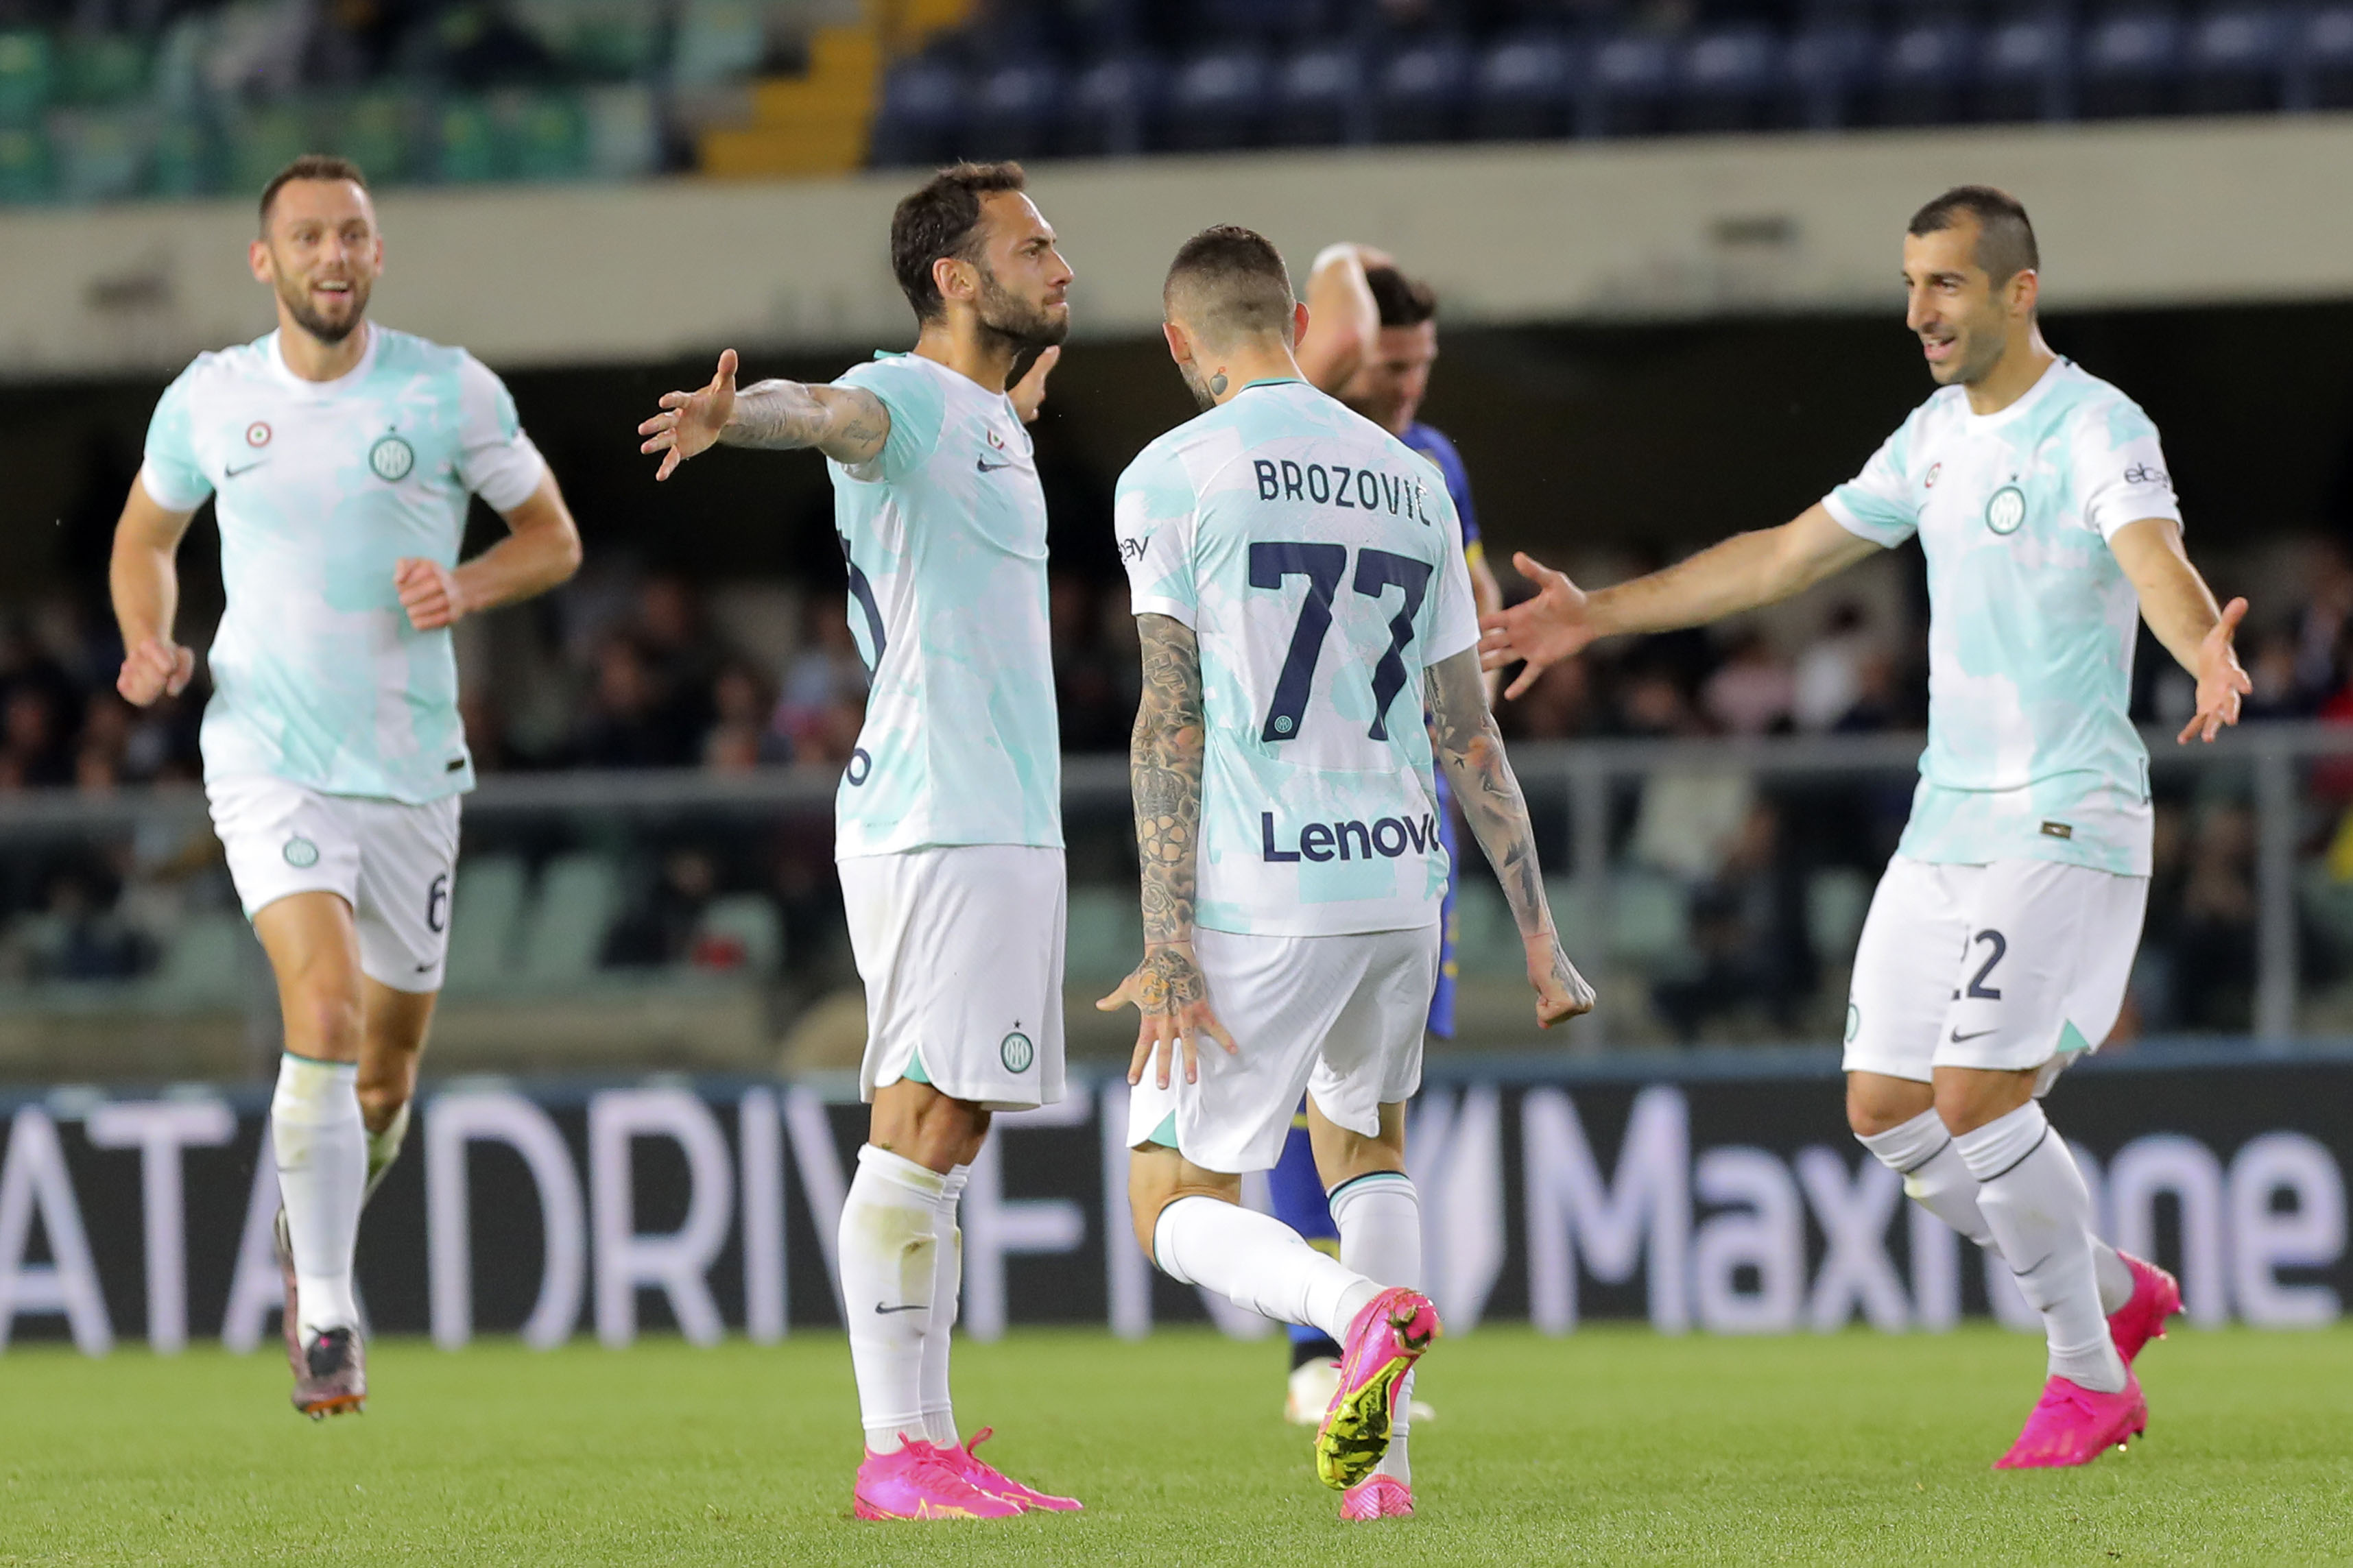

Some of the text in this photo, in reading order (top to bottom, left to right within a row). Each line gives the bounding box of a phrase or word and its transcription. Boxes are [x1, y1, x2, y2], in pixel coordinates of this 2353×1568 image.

[1249, 541, 1433, 742] 77
[427, 872, 446, 933] 6
[1951, 928, 2006, 1000] 2
[1520, 1085, 2350, 1338] Maxine
